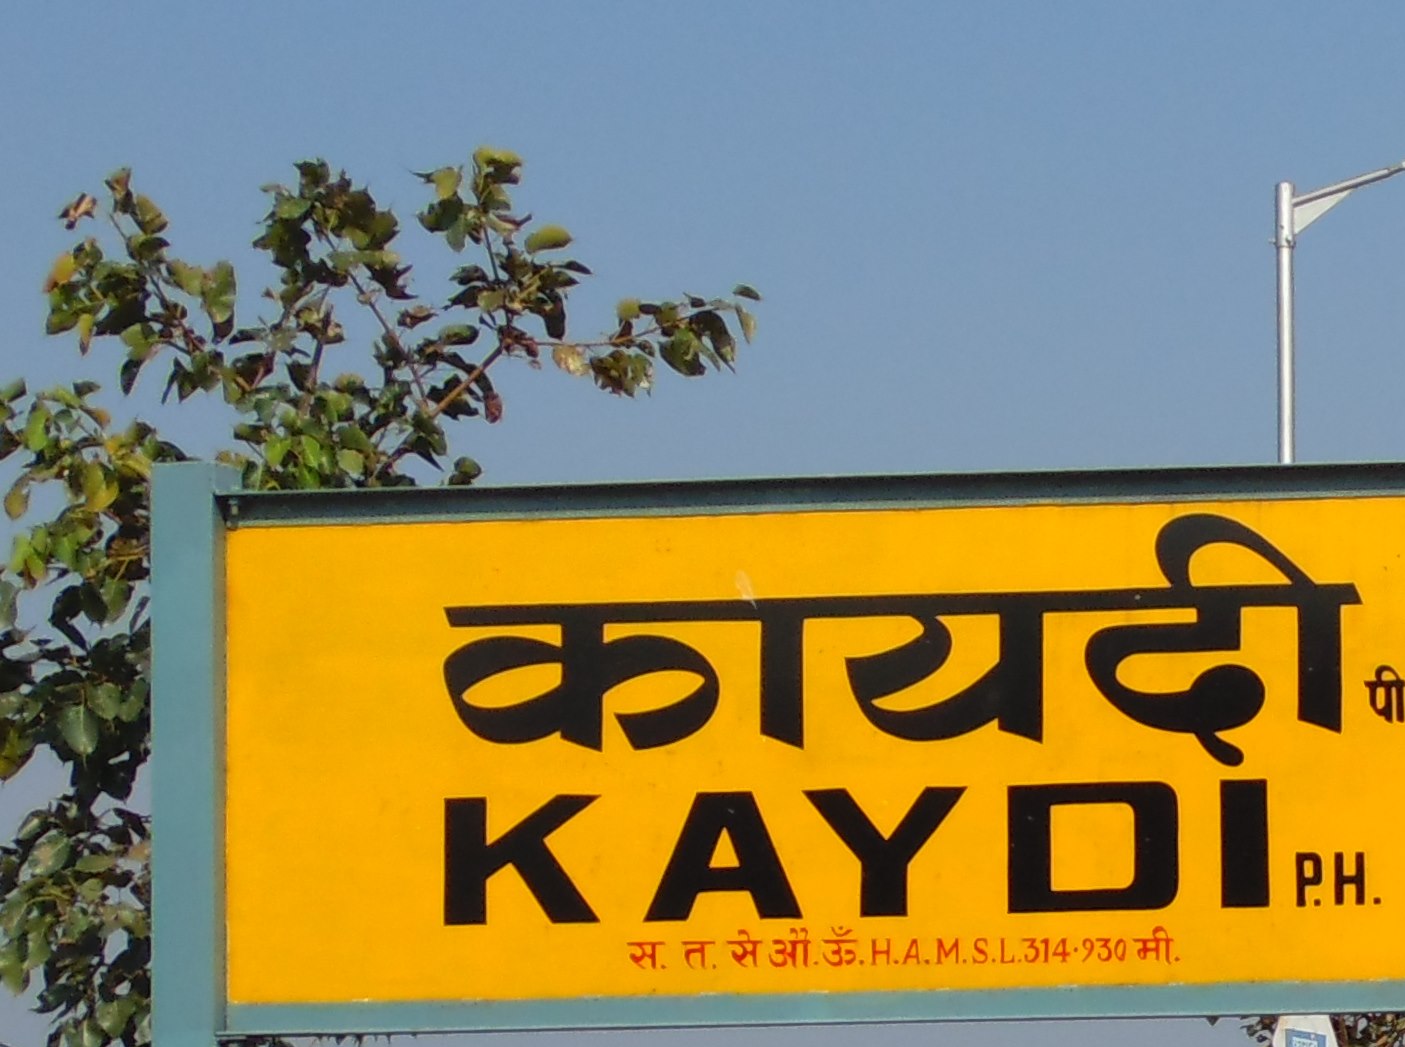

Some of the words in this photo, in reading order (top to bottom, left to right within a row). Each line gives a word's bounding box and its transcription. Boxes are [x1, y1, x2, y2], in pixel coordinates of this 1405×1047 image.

[443, 513, 1362, 767] कायदी
[444, 779, 1271, 926] KAYDI
[1295, 851, 1382, 908] P.H.
